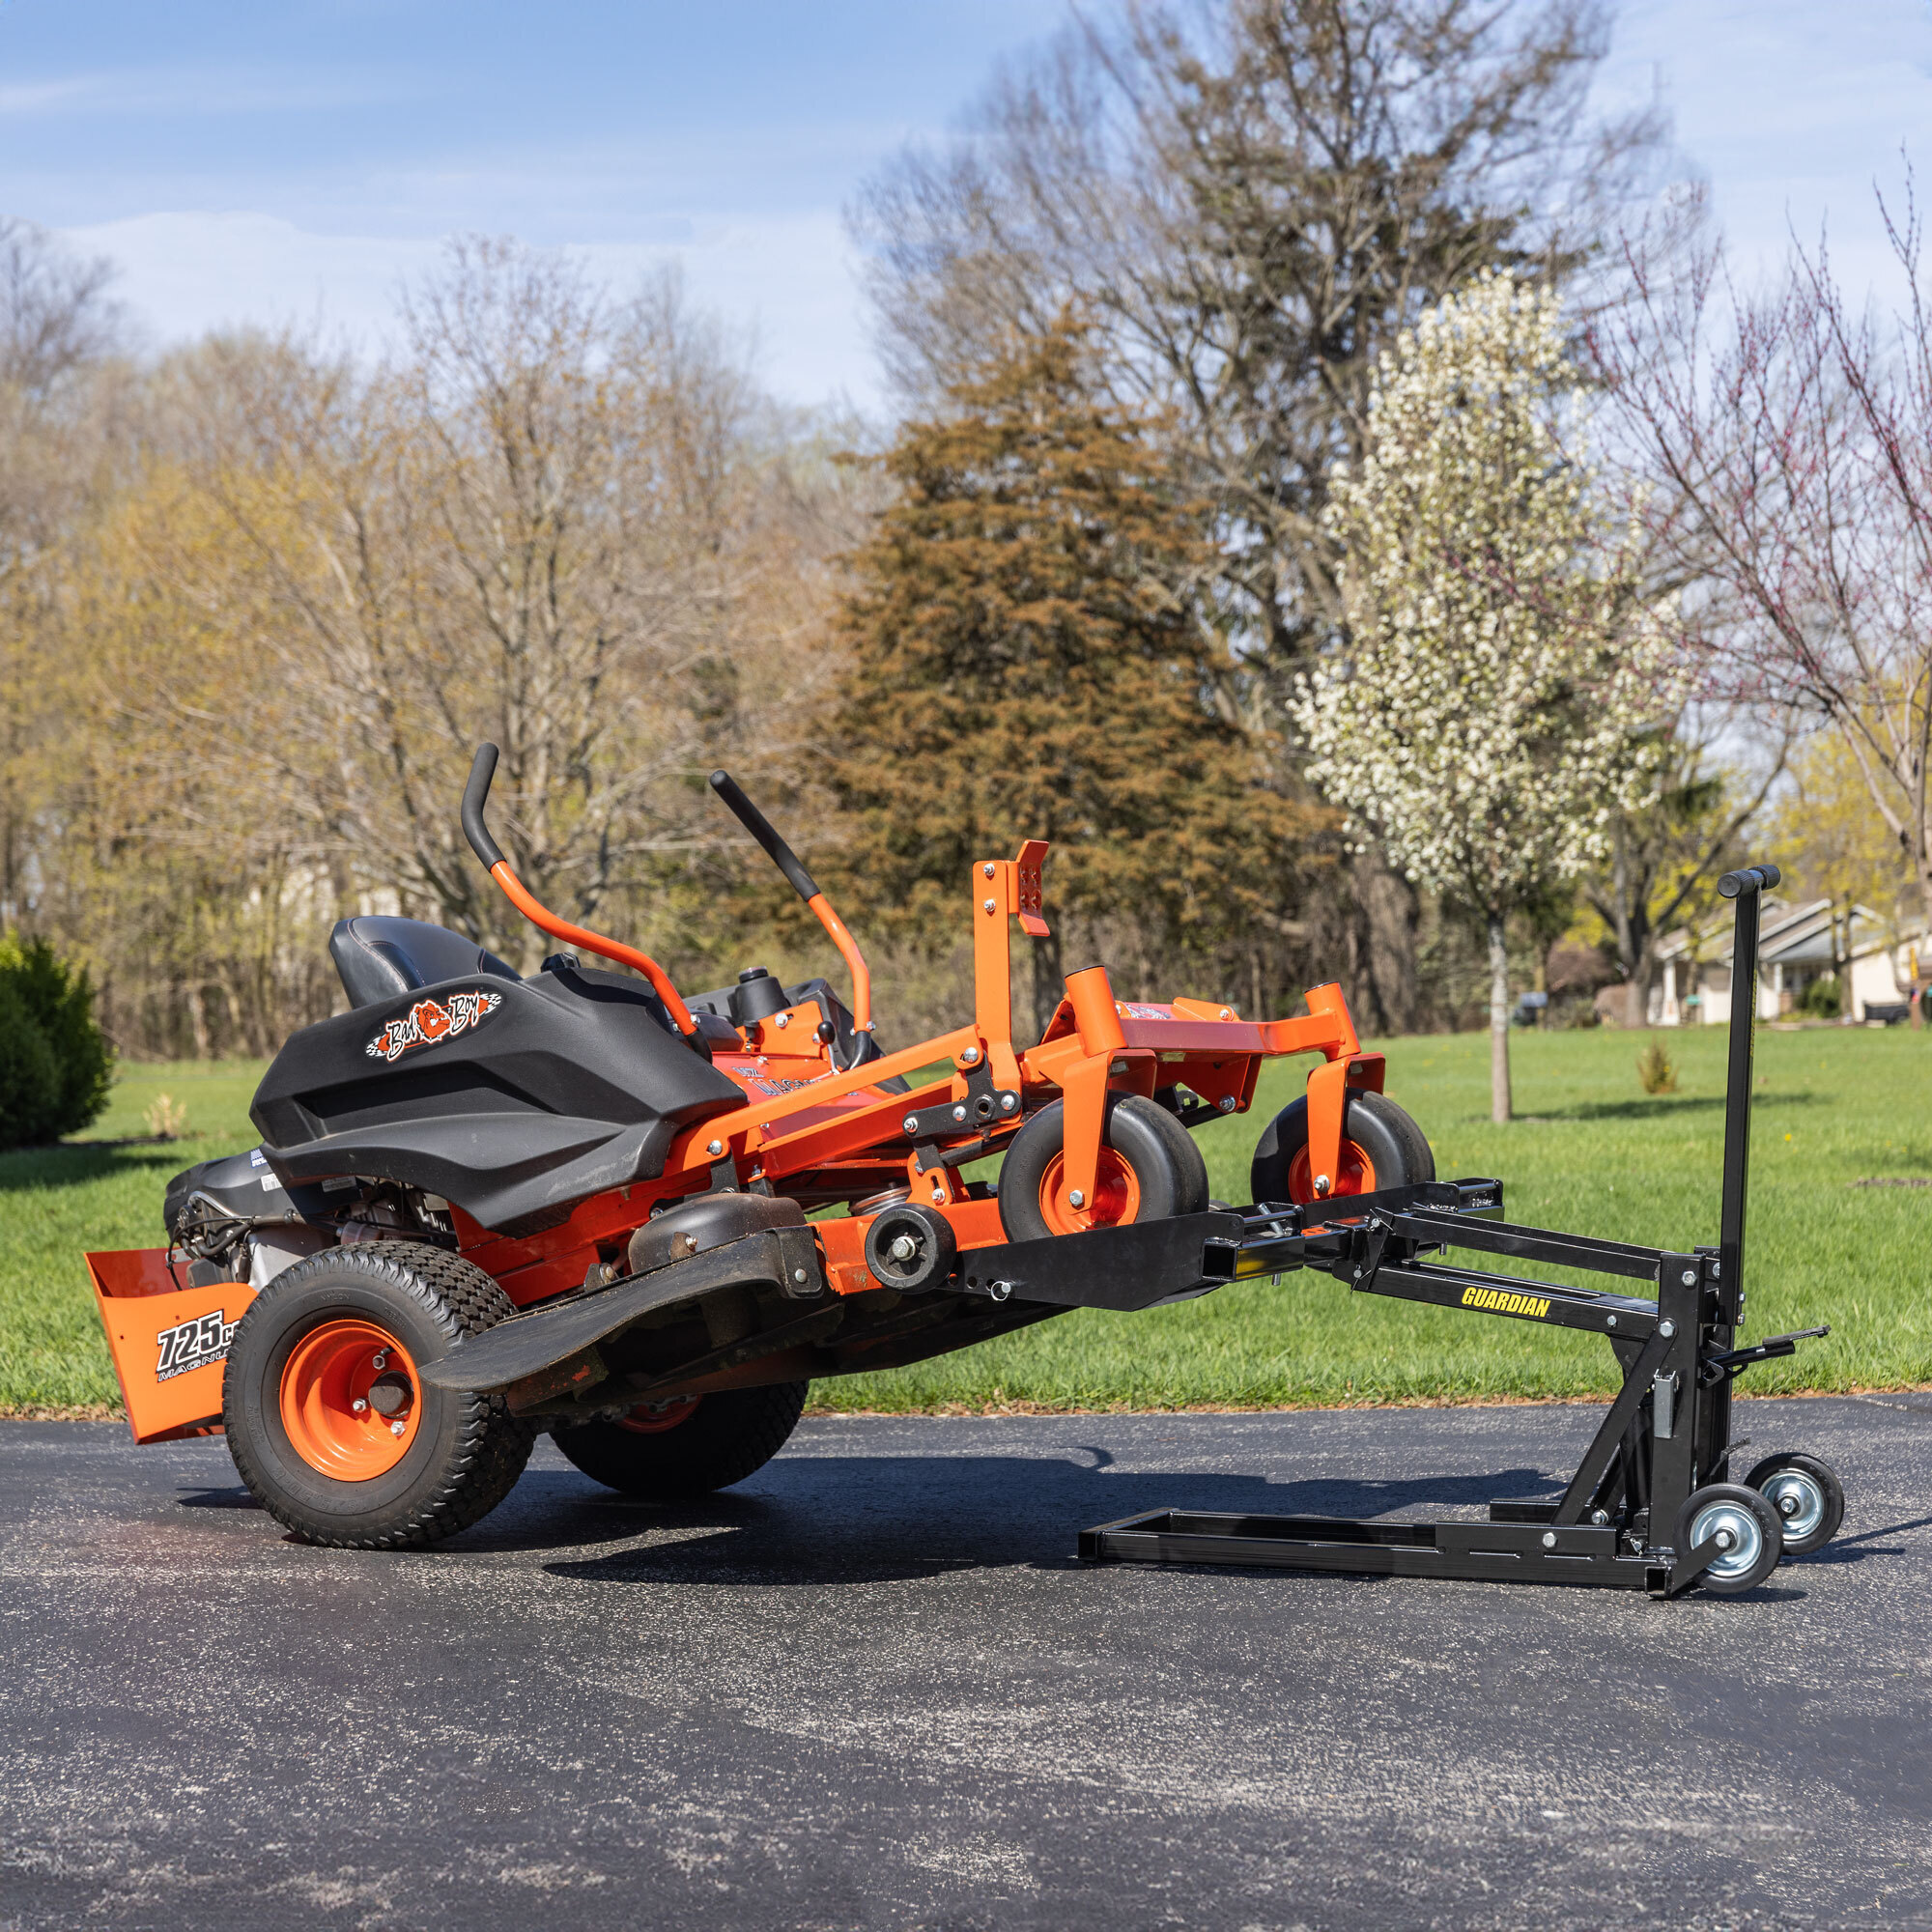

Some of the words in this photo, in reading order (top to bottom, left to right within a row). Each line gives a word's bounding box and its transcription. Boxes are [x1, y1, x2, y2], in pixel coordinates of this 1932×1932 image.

[449, 991, 480, 1036] Boy
[1462, 1287, 1551, 1318] GUARDIAN
[157, 1348, 229, 1382] MAGNU
